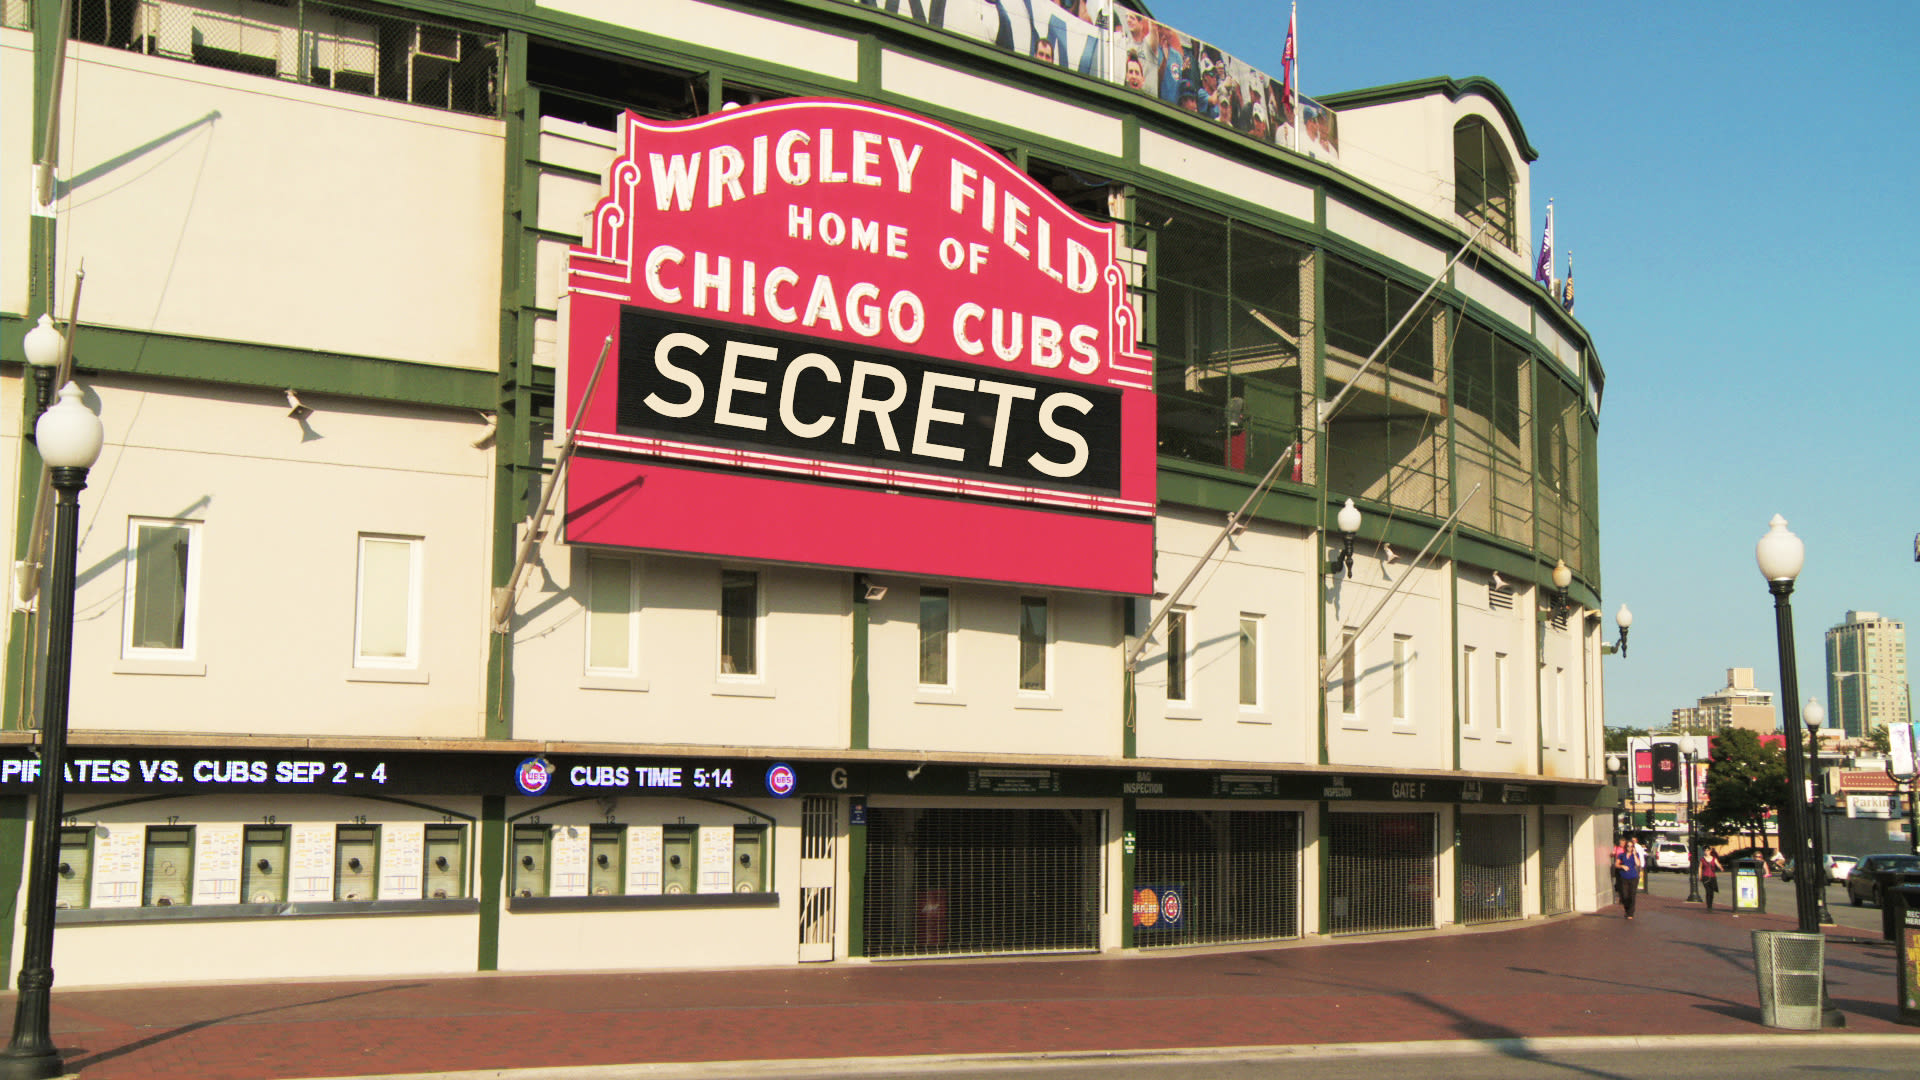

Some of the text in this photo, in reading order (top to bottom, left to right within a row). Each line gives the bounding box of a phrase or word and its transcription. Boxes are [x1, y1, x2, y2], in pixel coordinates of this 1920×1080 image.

[649, 128, 1099, 294] WRIGLEY FIELD
[788, 205, 990, 275] HOME OF
[644, 245, 1100, 375] CHICAGO CUBS
[643, 332, 1095, 478] SECRETS
[139, 760, 184, 783] VS.
[193, 760, 268, 783] CUBS
[275, 761, 326, 784] SEP
[332, 762, 348, 784] 2
[371, 762, 388, 785] 4
[571, 766, 733, 788] CUBS TIME 5:14
[831, 767, 848, 789] G
[1123, 783, 1164, 794] INSPECTION
[1392, 781, 1426, 799] GATE F
[1853, 797, 1896, 811] Parking
[167, 816, 179, 825] 17
[530, 816, 540, 825] 13
[606, 815, 616, 825] 12
[678, 816, 685, 825] 11
